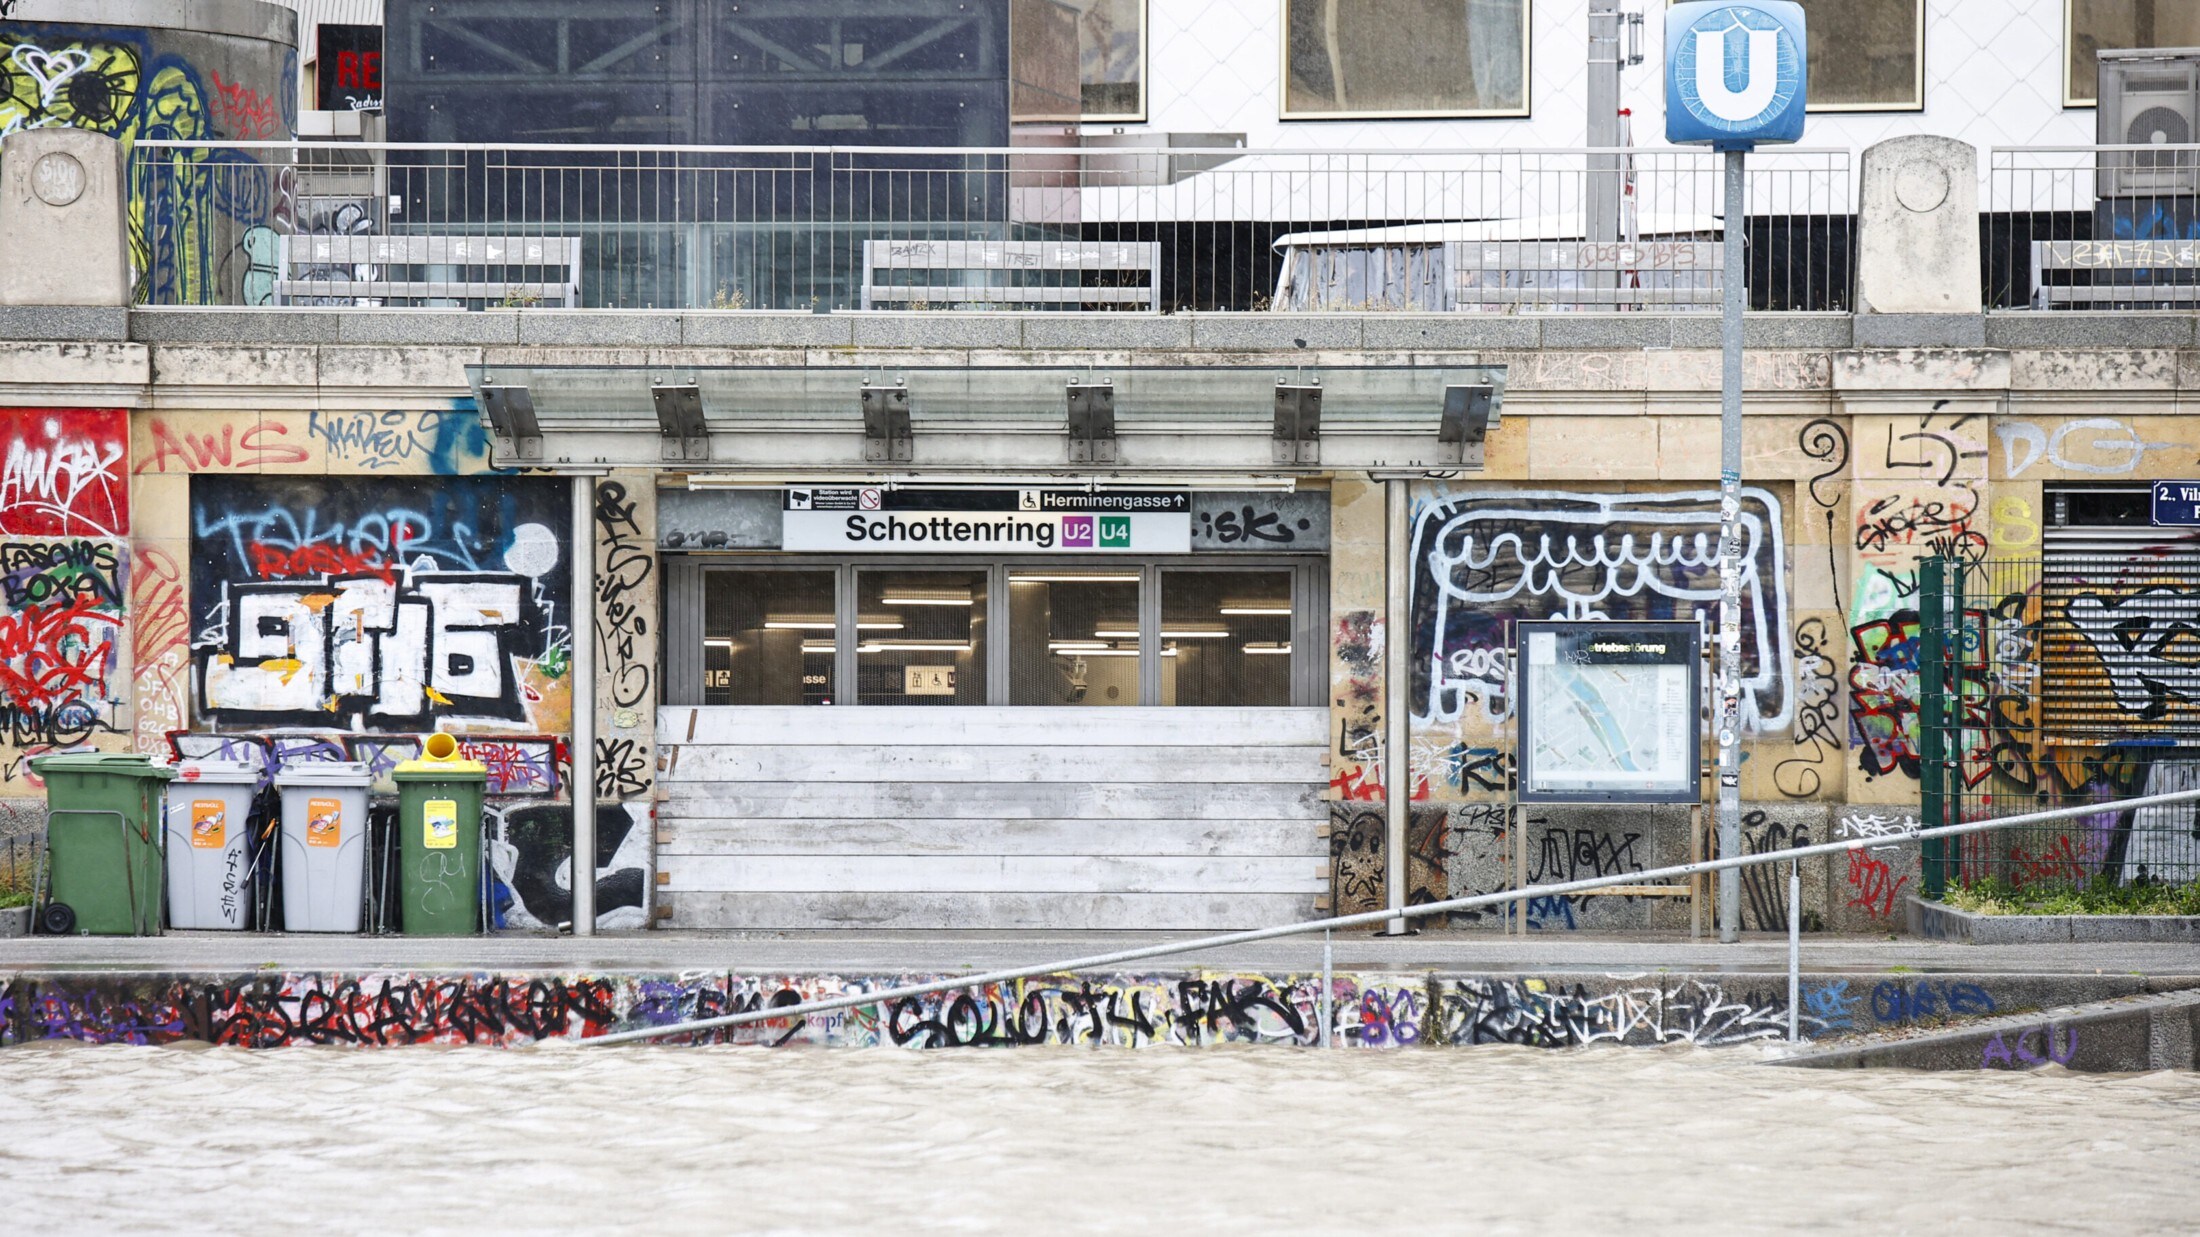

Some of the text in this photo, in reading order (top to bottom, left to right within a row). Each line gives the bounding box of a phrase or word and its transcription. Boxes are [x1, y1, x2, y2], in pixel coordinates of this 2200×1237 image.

[1696, 29, 1777, 121] U
[1043, 493, 1172, 511] Herminengasse
[2180, 487, 2200, 501] Vil
[845, 514, 1129, 548] Schottenring U2 U4
[1583, 642, 1666, 655] etriebsstörung
